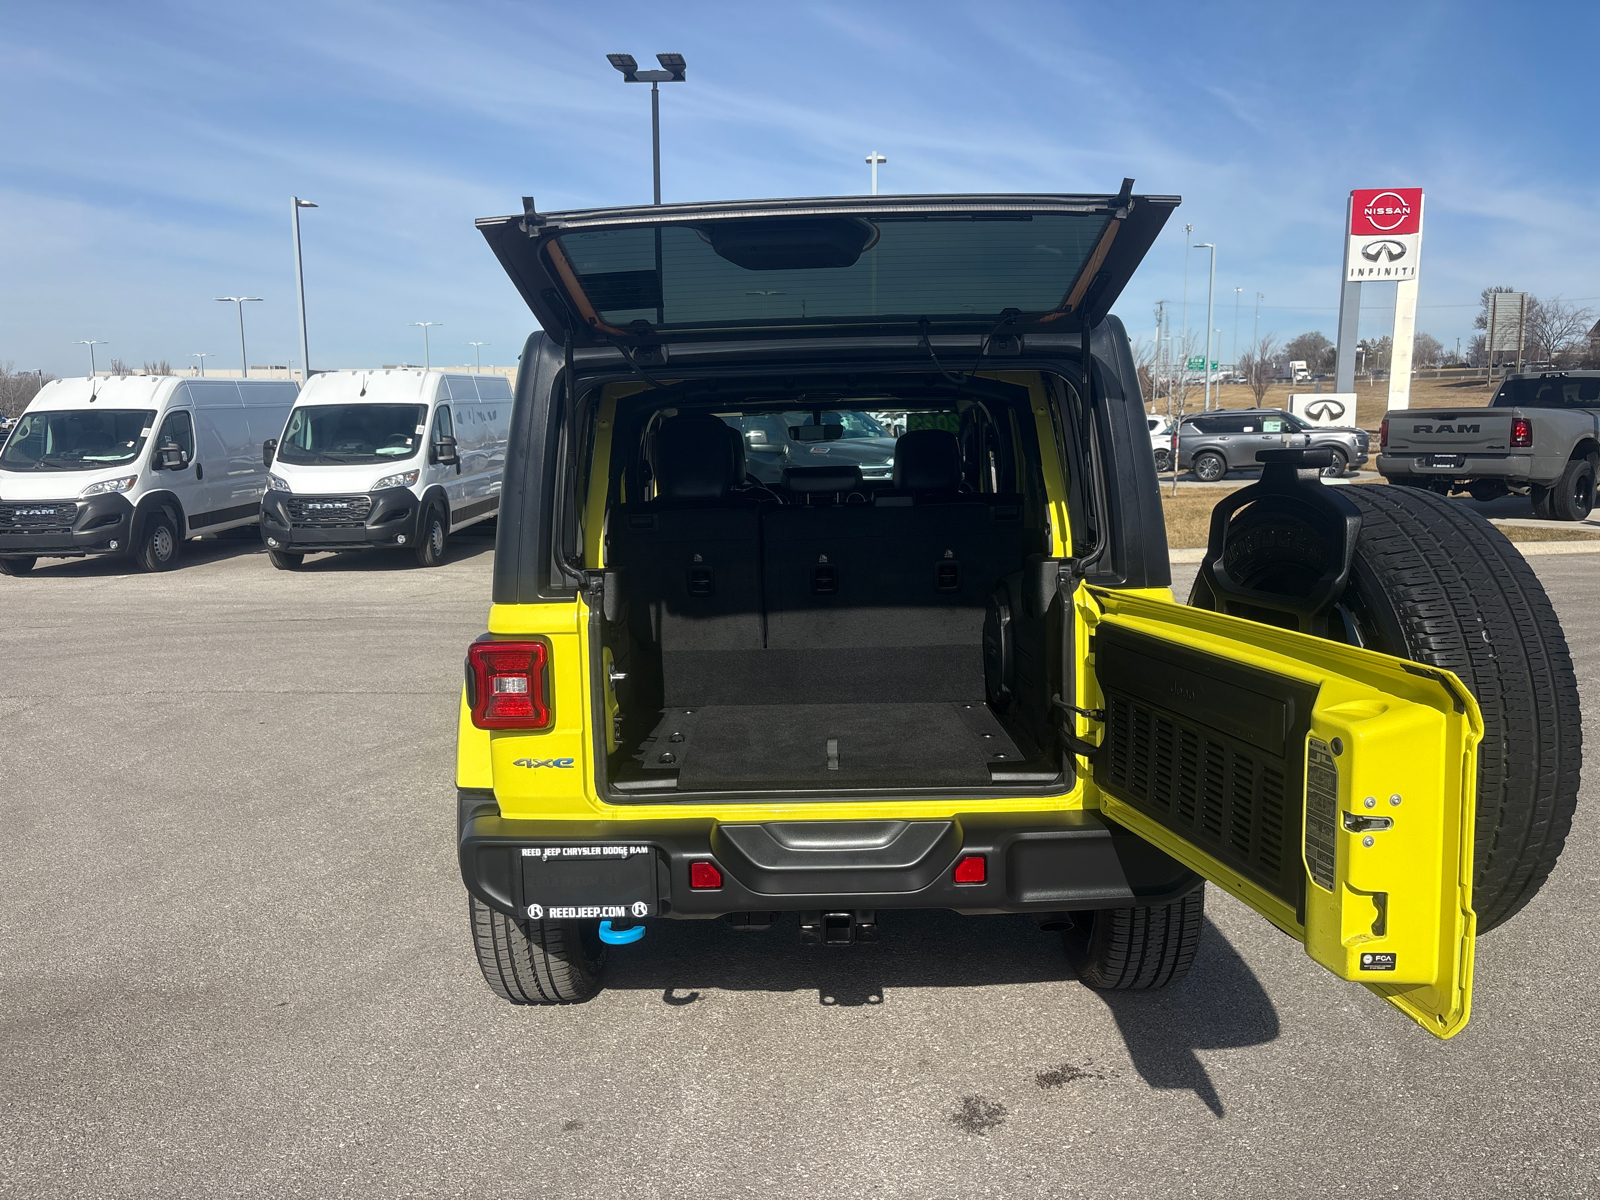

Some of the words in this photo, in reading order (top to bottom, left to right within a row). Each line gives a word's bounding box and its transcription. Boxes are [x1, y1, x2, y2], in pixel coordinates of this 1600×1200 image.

[1364, 207, 1411, 215] NISSAN
[1350, 266, 1415, 277] INFINITI
[1412, 424, 1480, 434] RAM
[521, 848, 541, 857] REED
[542, 847, 561, 856] JEEP
[562, 846, 601, 856] CHRYSLER
[602, 846, 628, 855] DODGE
[629, 845, 649, 854] RAM
[549, 906, 625, 918] REEDJEEP.COM
